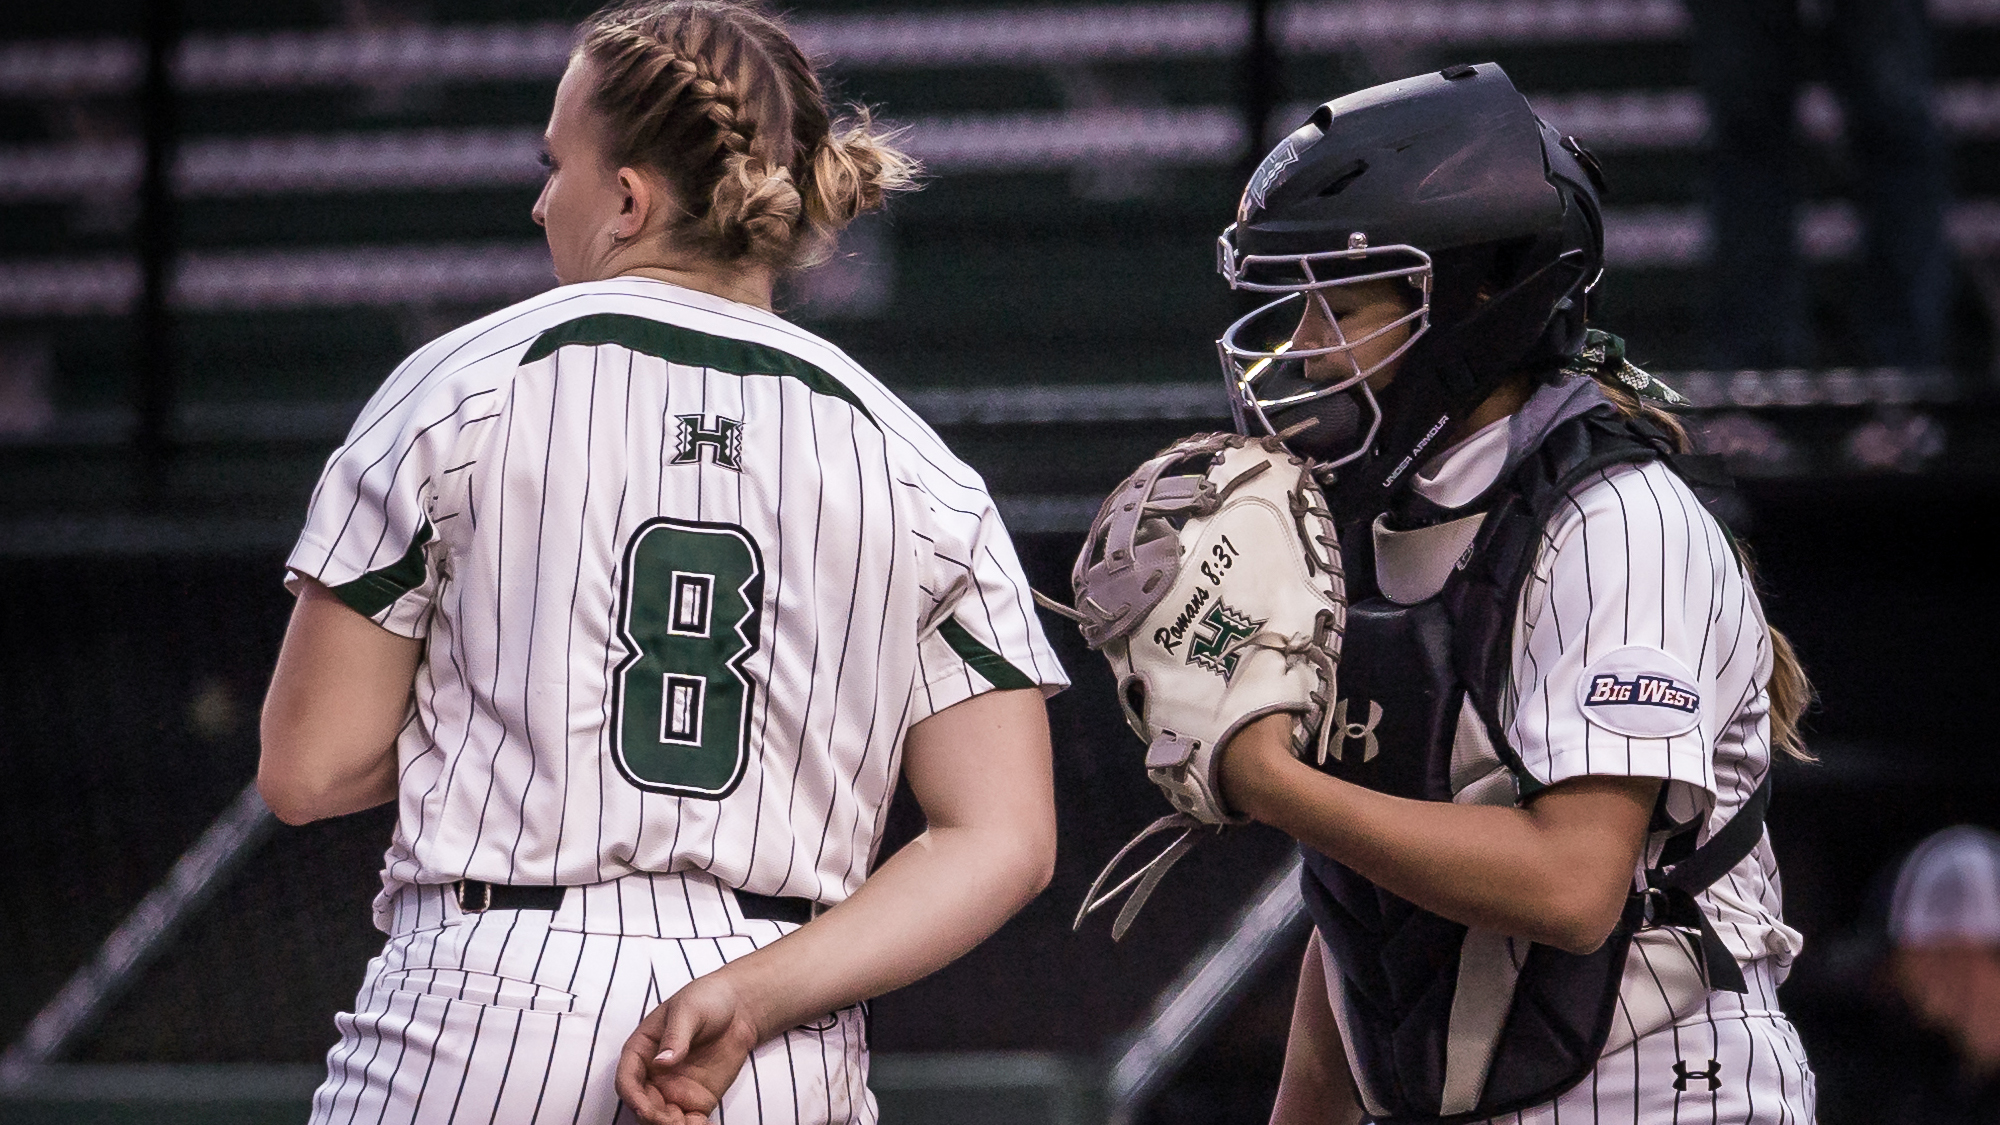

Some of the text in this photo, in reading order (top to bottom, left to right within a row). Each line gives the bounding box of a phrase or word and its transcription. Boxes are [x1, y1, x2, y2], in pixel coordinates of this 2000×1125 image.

[1382, 415, 1449, 487] UNDER ARMOUR
[1154, 534, 1239, 656] Romans 8:31
[609, 516, 765, 800] 8
